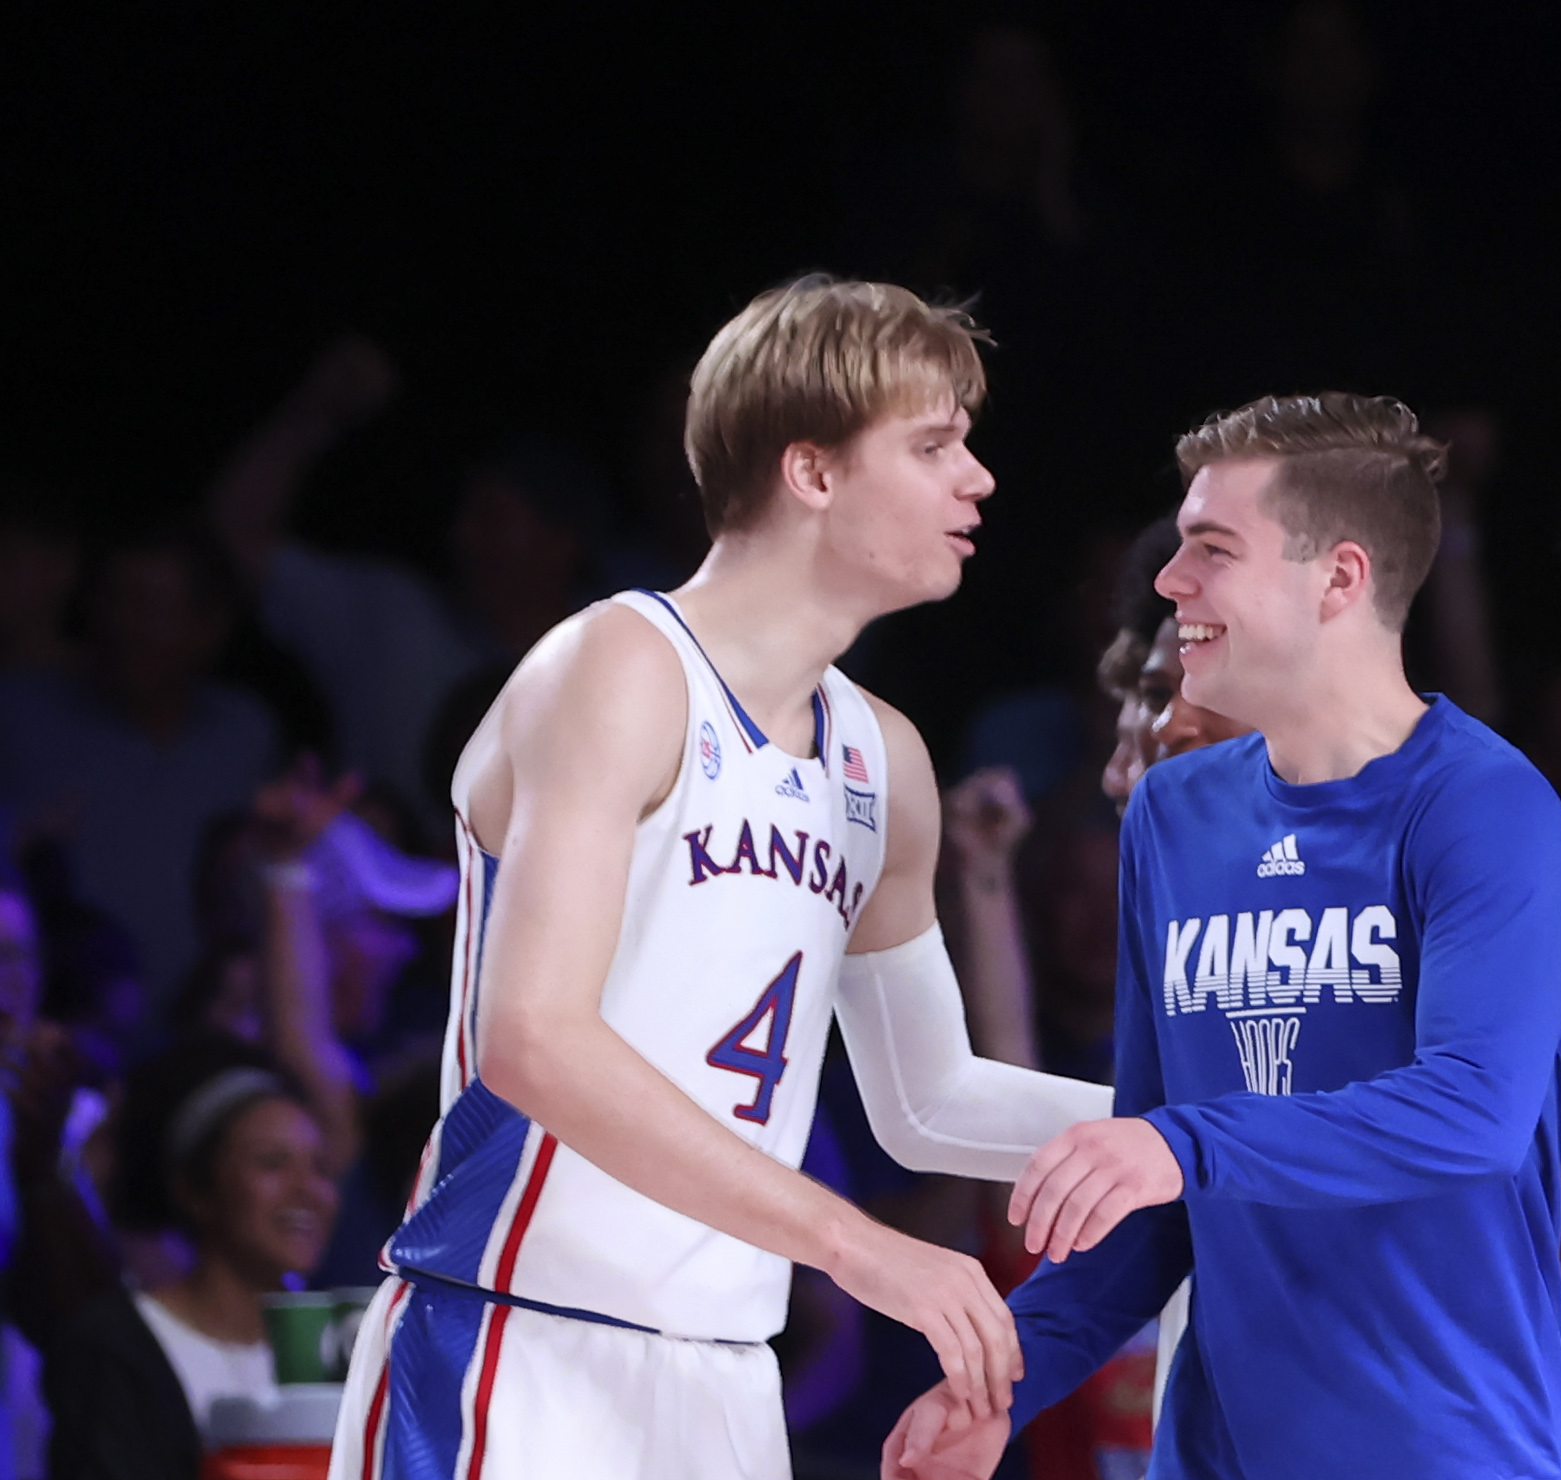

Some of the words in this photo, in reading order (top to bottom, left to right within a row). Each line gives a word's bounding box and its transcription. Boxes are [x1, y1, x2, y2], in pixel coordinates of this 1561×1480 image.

[1257, 861, 1305, 878] adidas
[1163, 905, 1402, 1017] KANSAS
[705, 949, 803, 1126] 4
[1230, 1017, 1301, 1096] HOOPS
